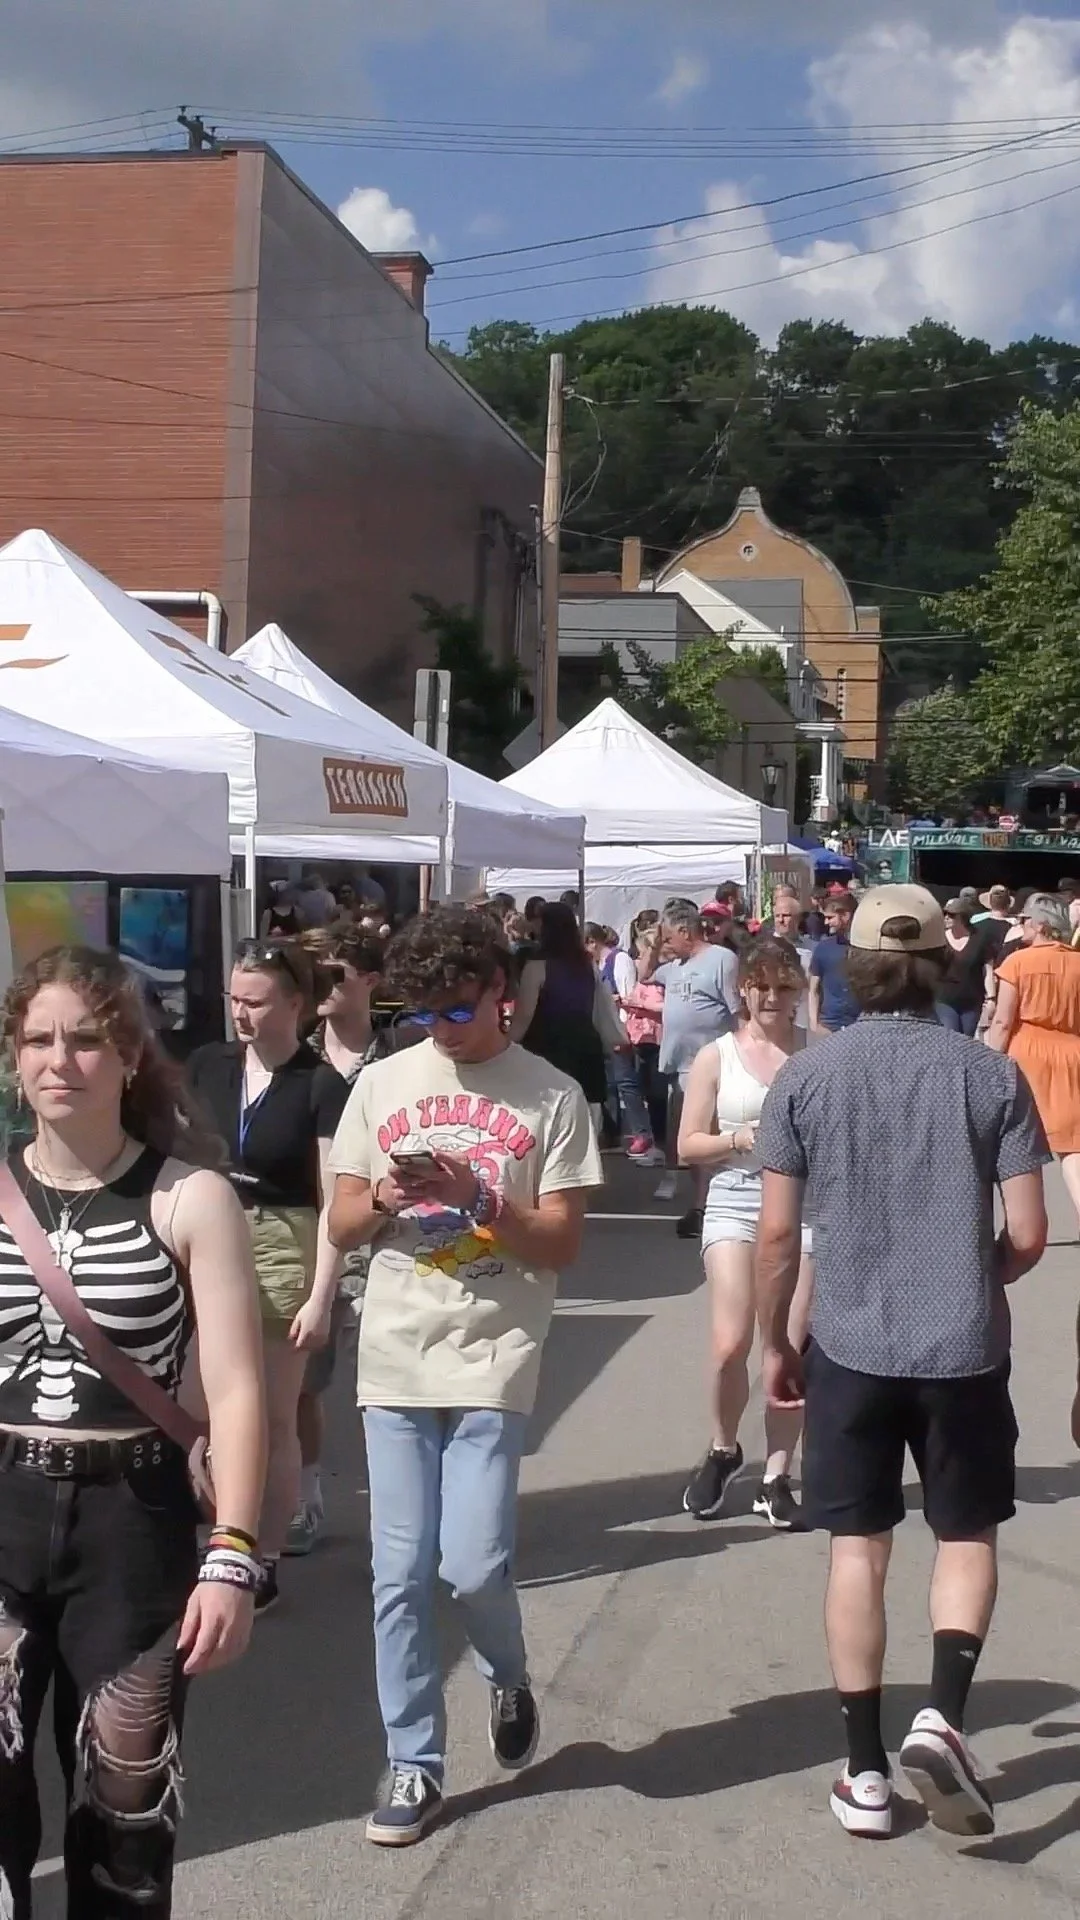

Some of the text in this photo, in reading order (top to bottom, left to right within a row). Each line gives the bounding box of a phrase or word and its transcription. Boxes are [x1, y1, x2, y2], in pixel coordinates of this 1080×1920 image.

[326, 767, 405, 808] TERRAPIN
[377, 1094, 537, 1161] OH YEAAHH
